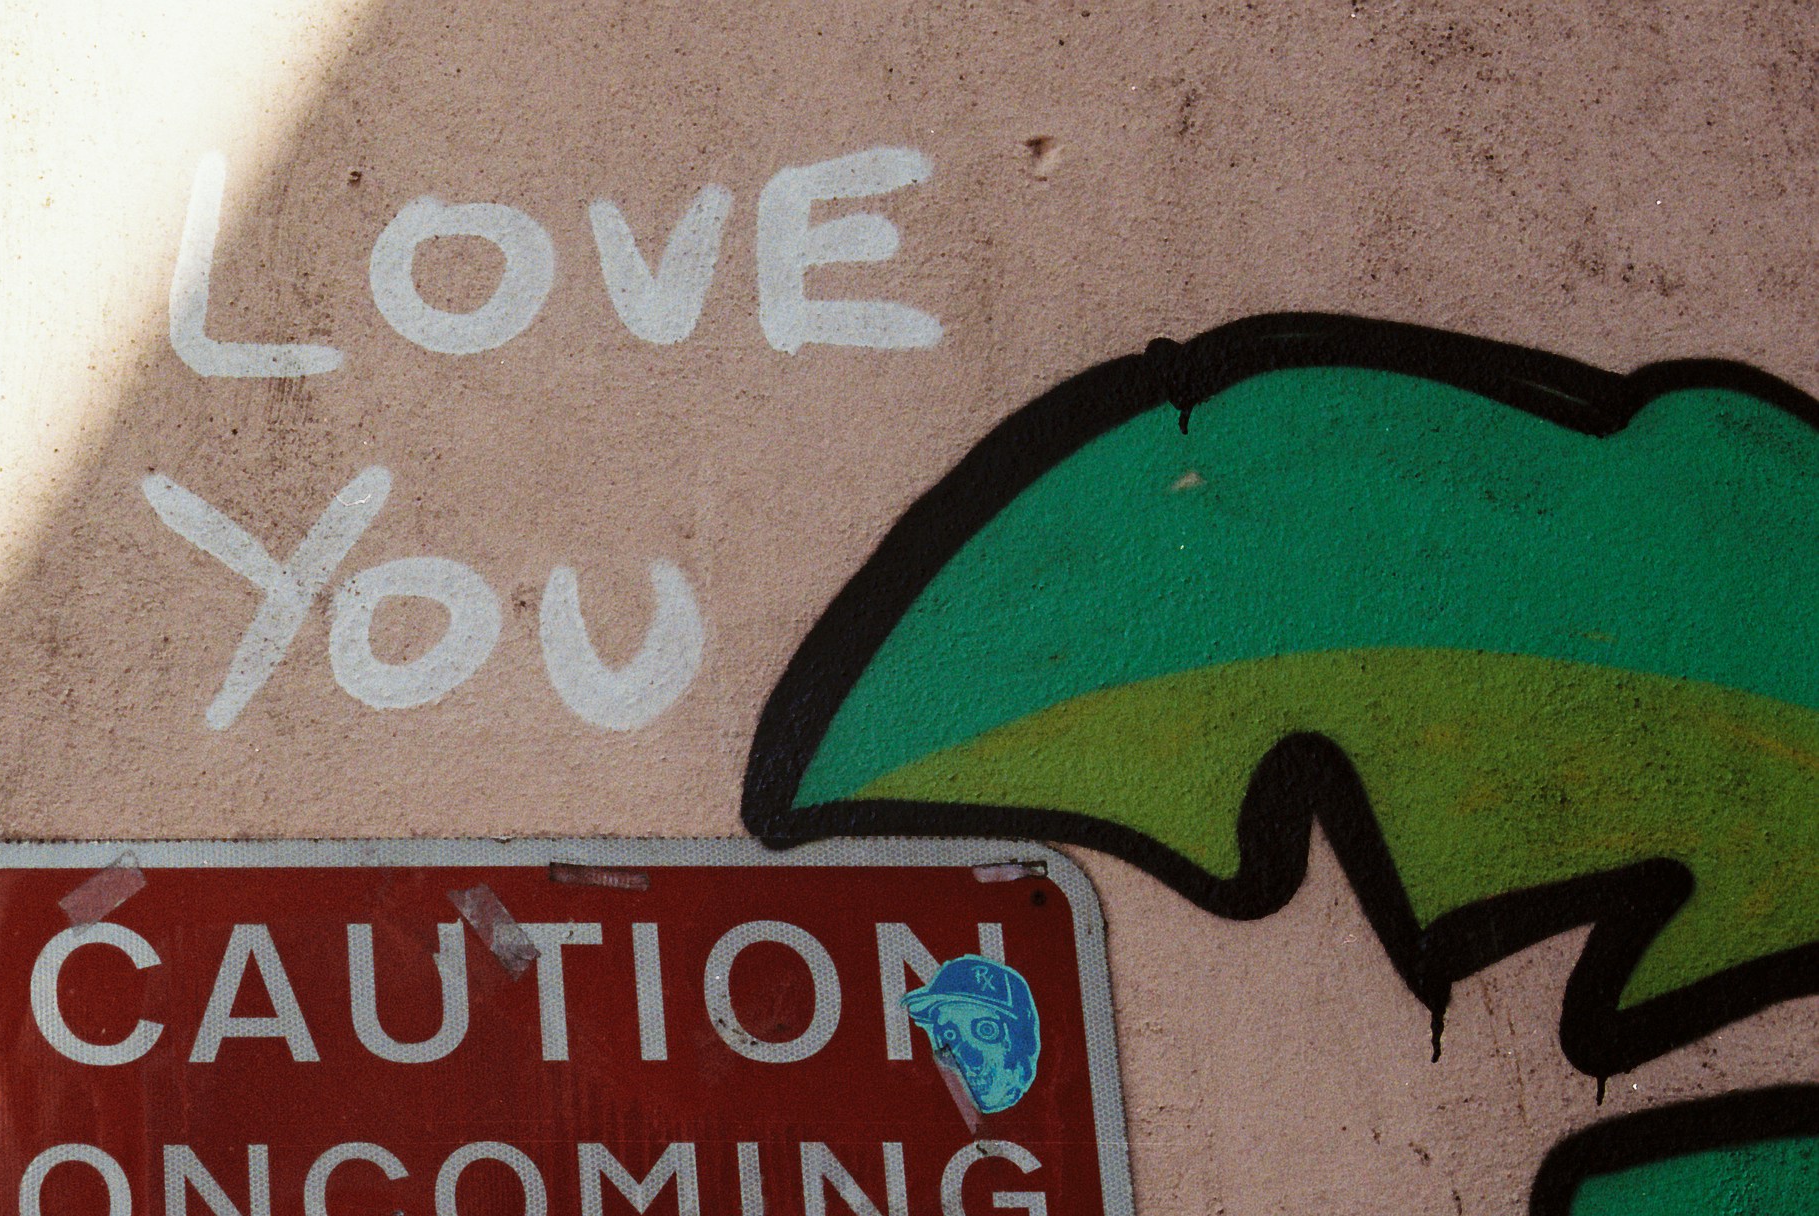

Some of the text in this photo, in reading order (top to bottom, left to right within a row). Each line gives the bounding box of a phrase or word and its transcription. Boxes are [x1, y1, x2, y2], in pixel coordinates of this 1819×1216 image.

[167, 146, 945, 379] LOVE
[140, 464, 705, 733] YOU
[29, 919, 1011, 1067] CAUTION
